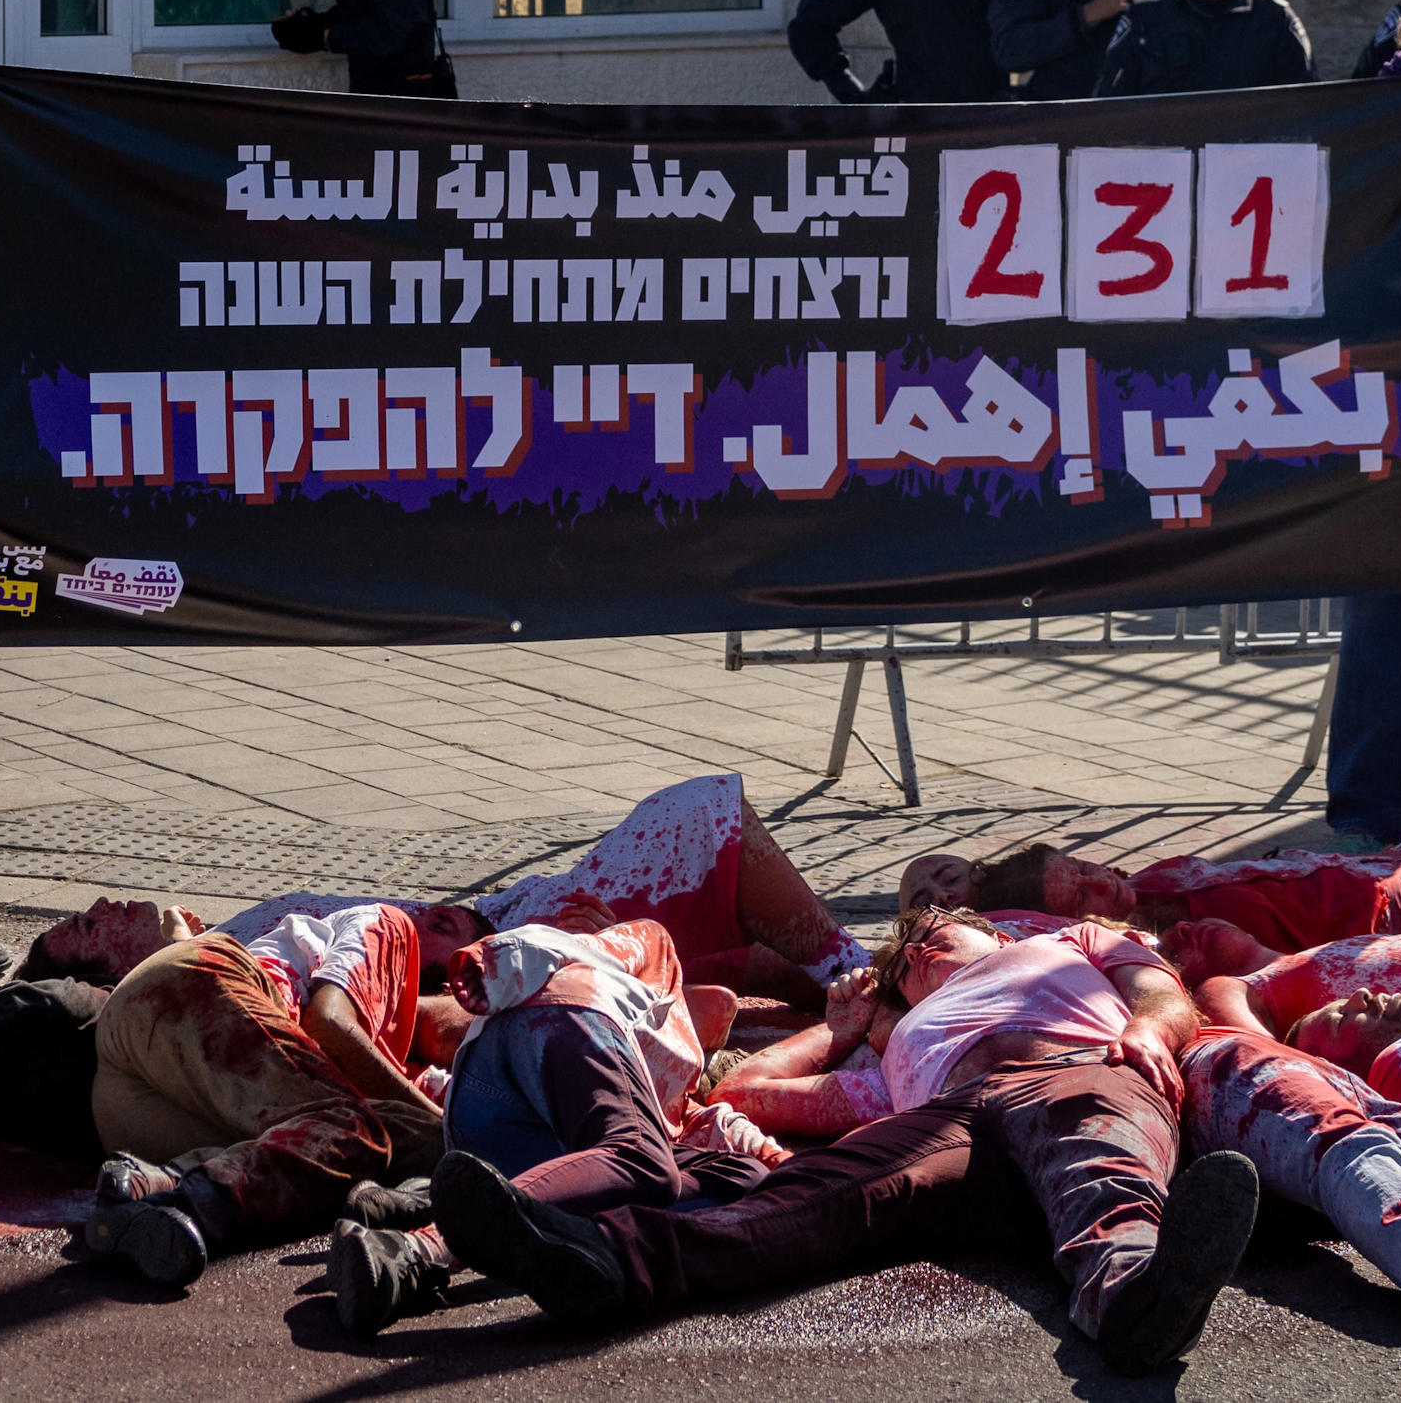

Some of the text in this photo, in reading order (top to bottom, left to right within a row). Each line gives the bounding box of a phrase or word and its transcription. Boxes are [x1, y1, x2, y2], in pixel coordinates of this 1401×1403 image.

[225, 137, 909, 239] قتيل منذ بداية السنة
[179, 248, 909, 327] נרצחים מתחילת השנה
[61, 347, 696, 495] דיי להפקרה.
[1122, 339, 1391, 520] بكفي
[63, 578, 176, 597] עומדים ביחד
